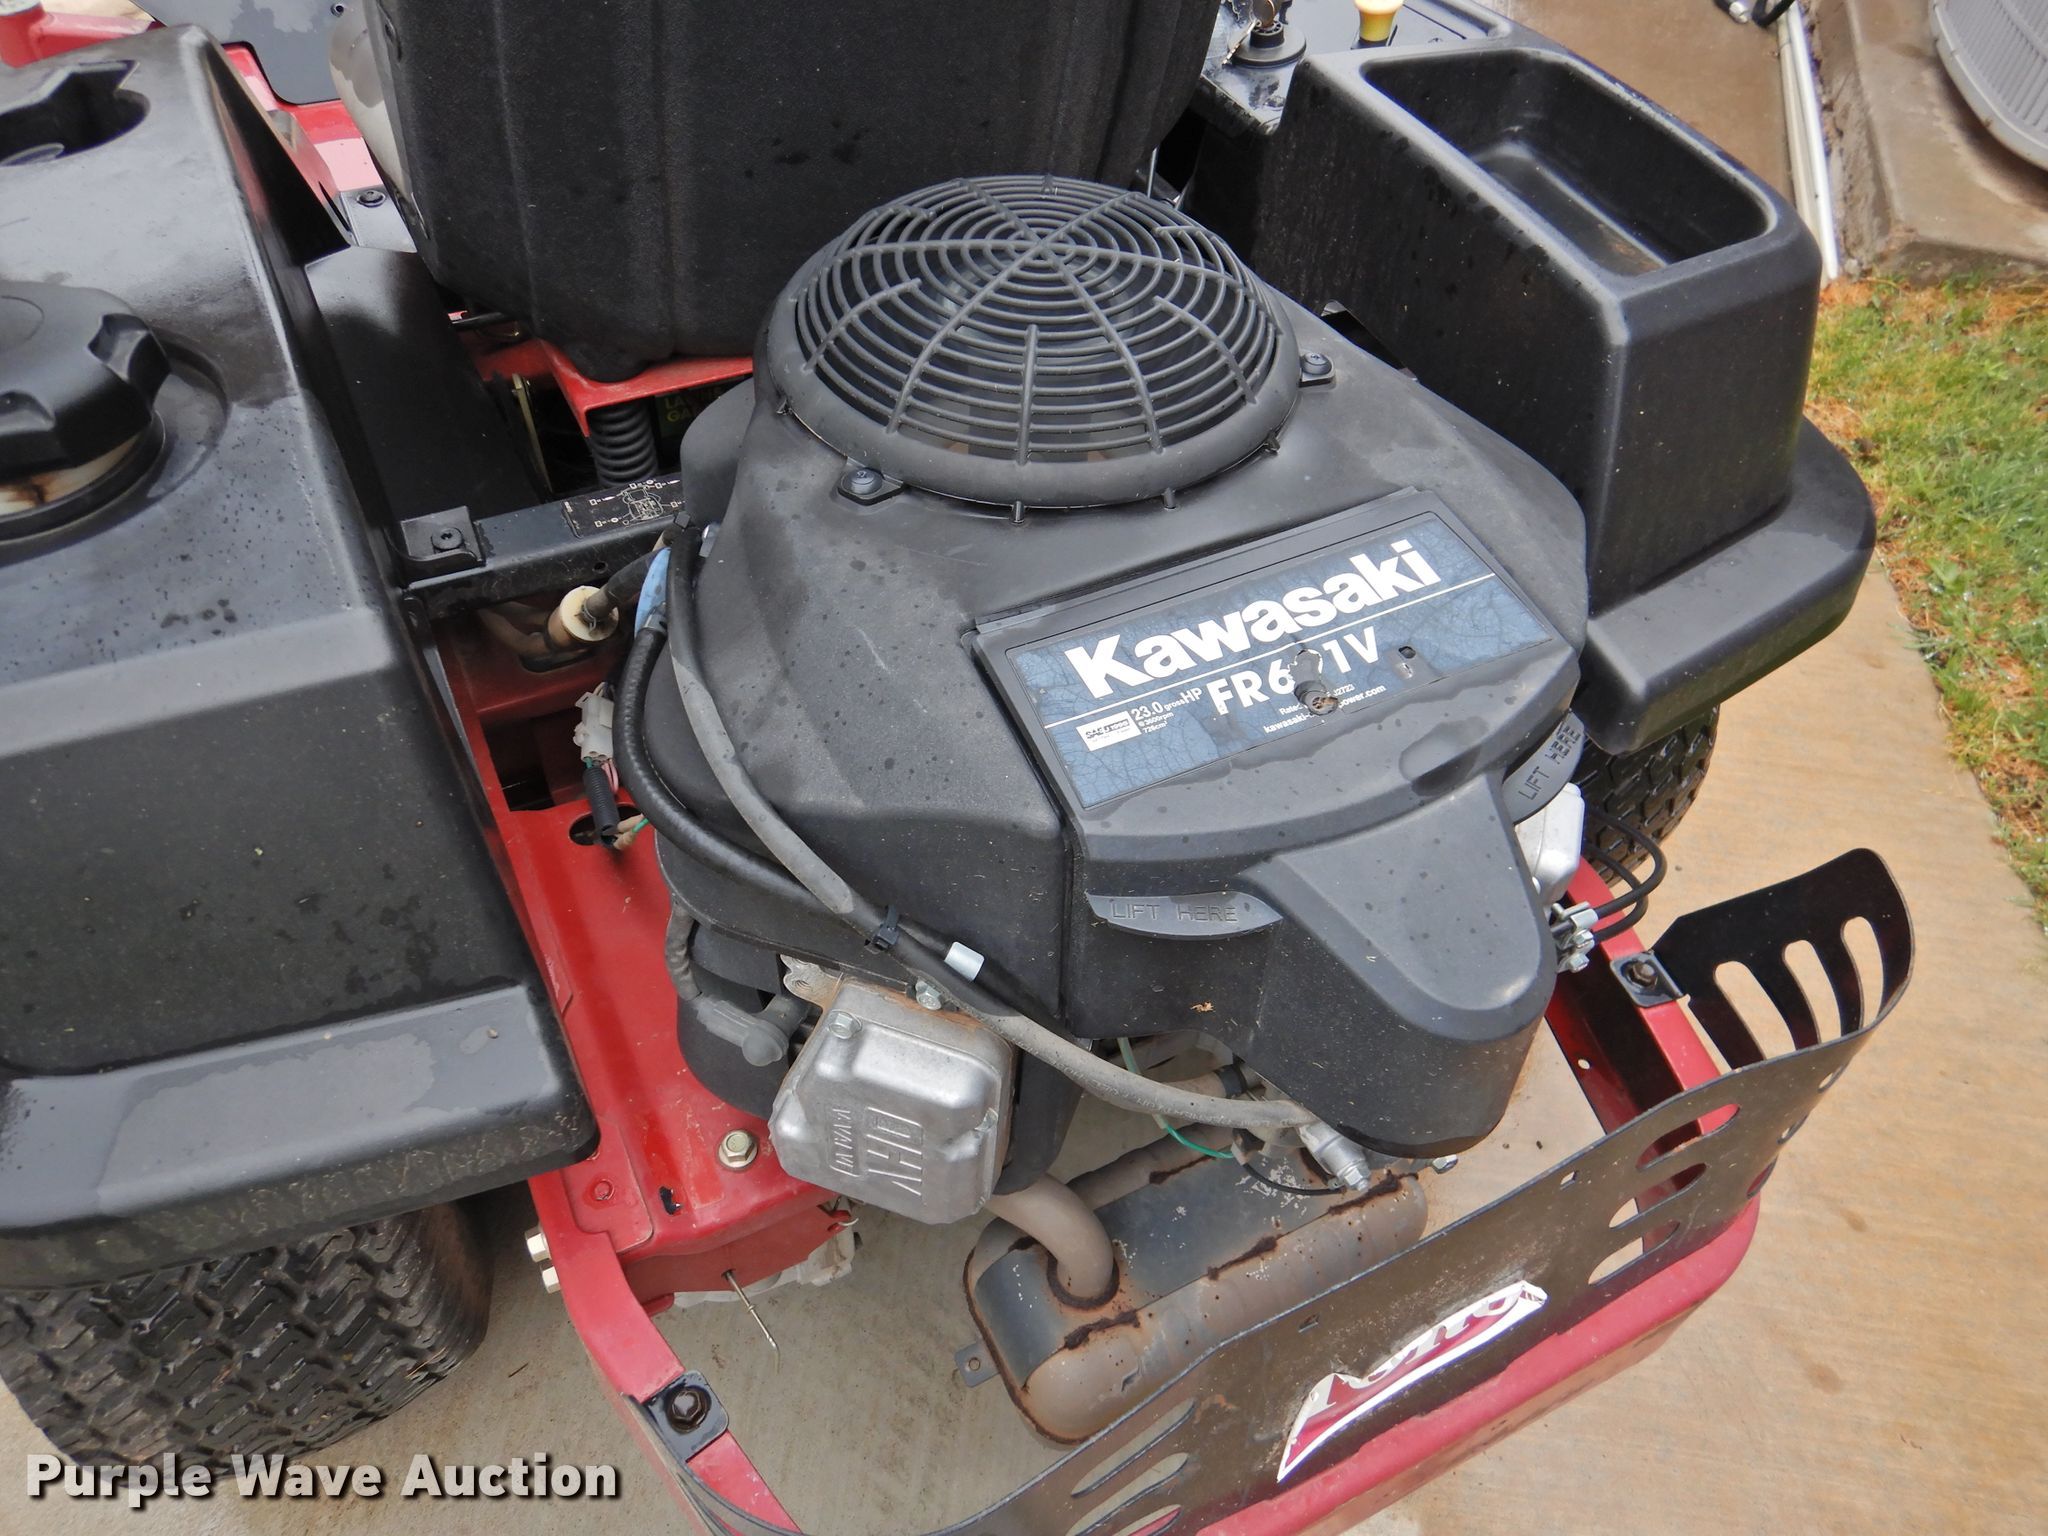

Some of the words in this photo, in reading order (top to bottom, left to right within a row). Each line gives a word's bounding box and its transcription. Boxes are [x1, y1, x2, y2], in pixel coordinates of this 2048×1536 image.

[1064, 539, 1442, 699] Kawasaki
[1206, 626, 1379, 716] FR61V
[1131, 701, 1164, 720] 23.0
[1517, 765, 1550, 800] LIFT
[1111, 903, 1161, 921] LIFT
[1176, 903, 1238, 923] HERE
